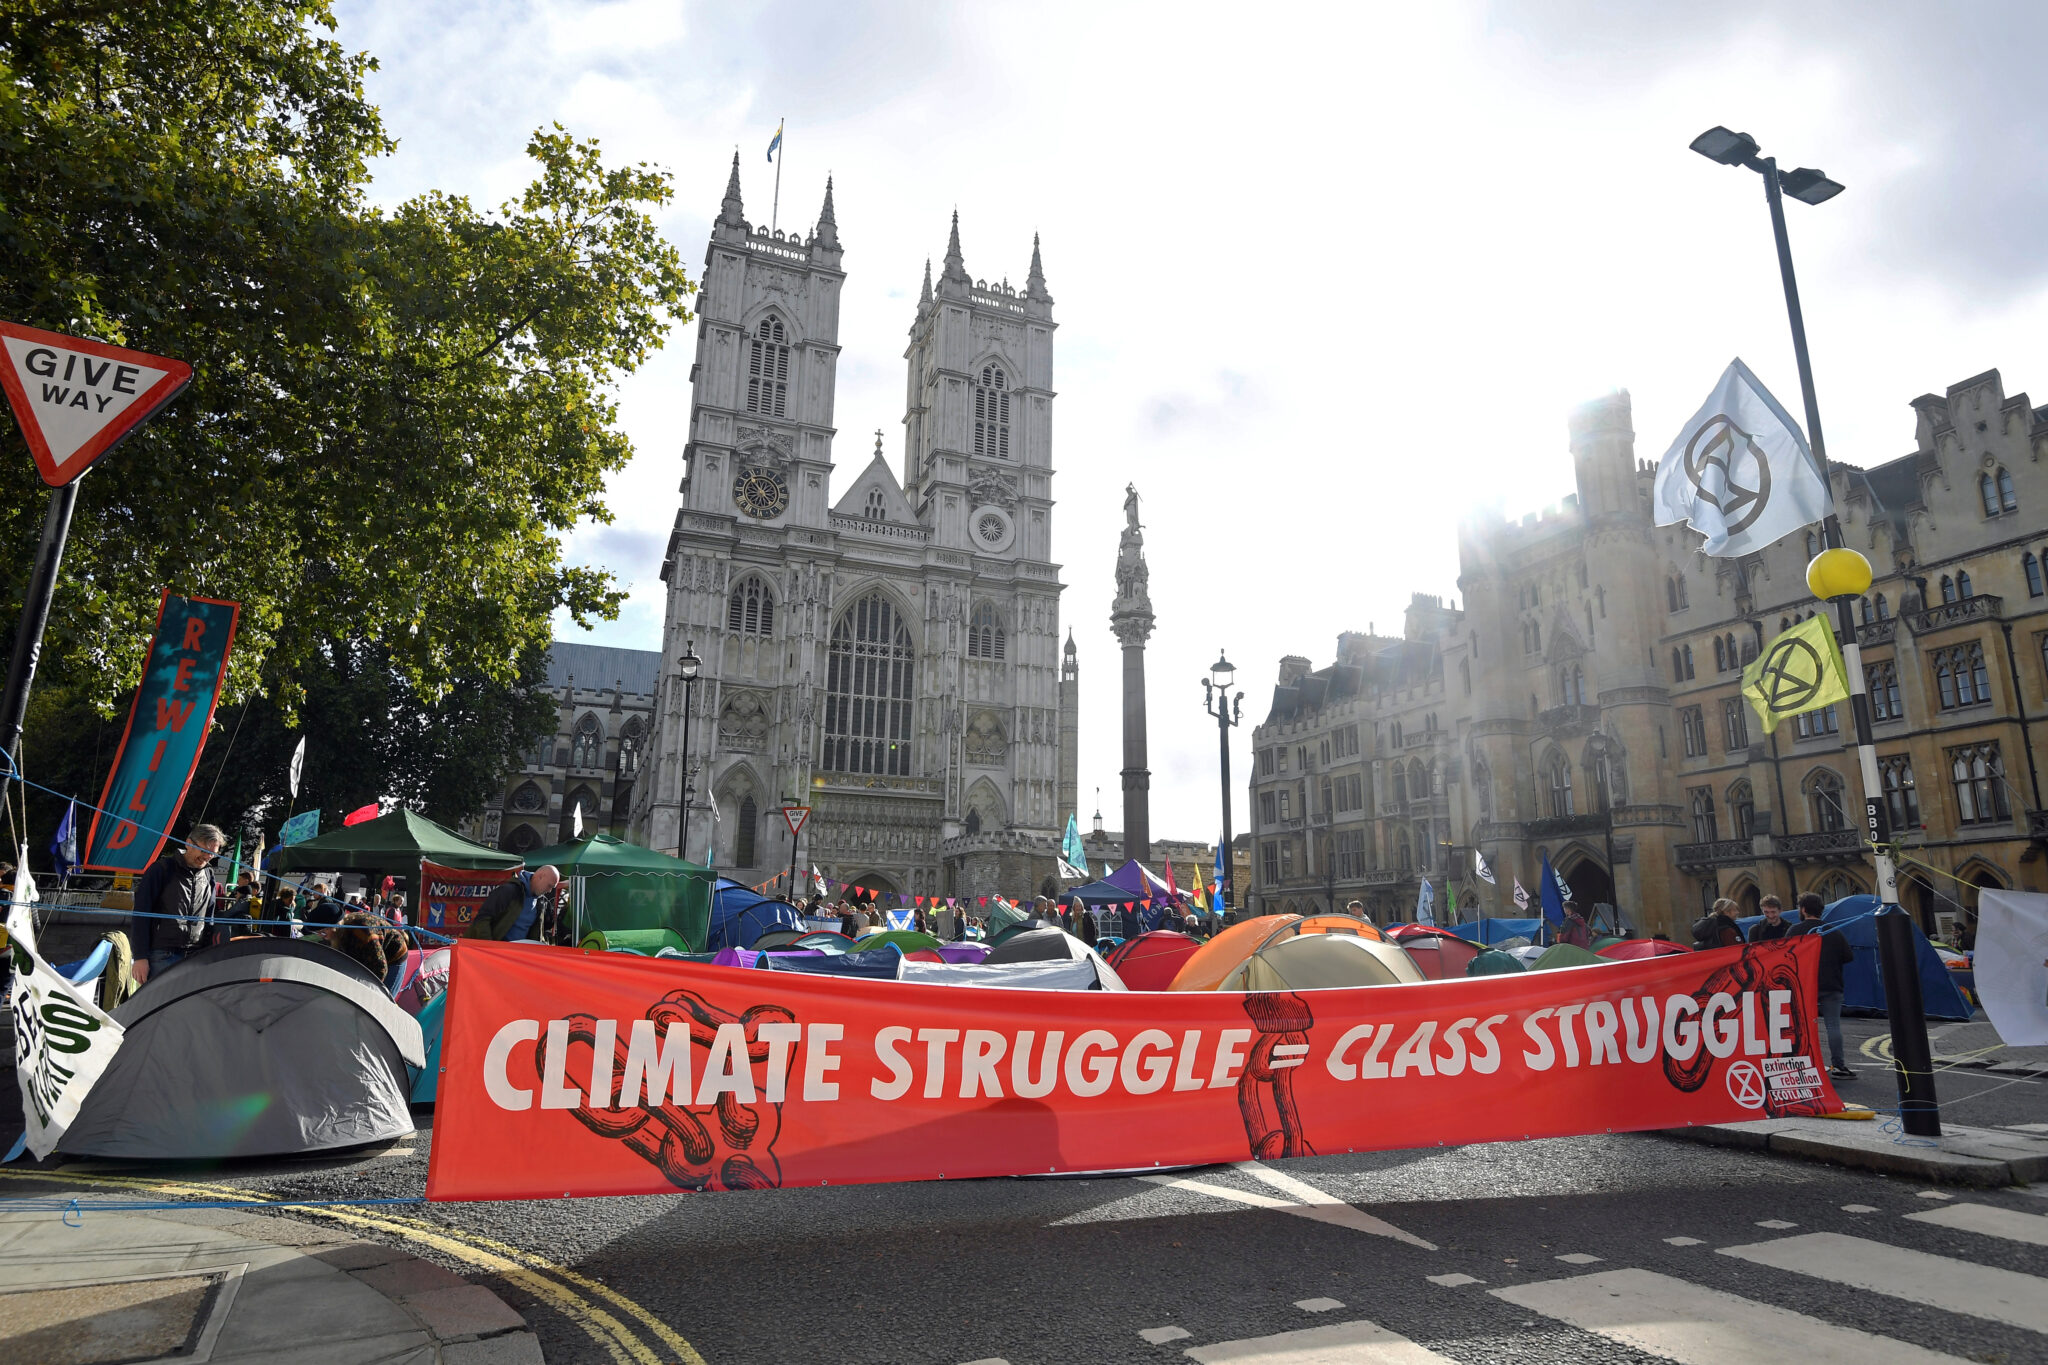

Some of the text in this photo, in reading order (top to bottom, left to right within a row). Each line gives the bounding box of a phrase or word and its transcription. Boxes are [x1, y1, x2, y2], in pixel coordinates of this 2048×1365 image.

[25, 348, 140, 394] GIVE
[42, 383, 113, 413] WAY
[106, 617, 205, 850] REWILD
[428, 881, 500, 897] NONVIOLEN
[483, 989, 1793, 1112] CLIMATE STRUGGLE = CLASS STRUGGLE
[1764, 1058, 1806, 1072] extinction
[1780, 1070, 1820, 1085] rebellion
[1773, 1088, 1814, 1101] SCOTLAND
